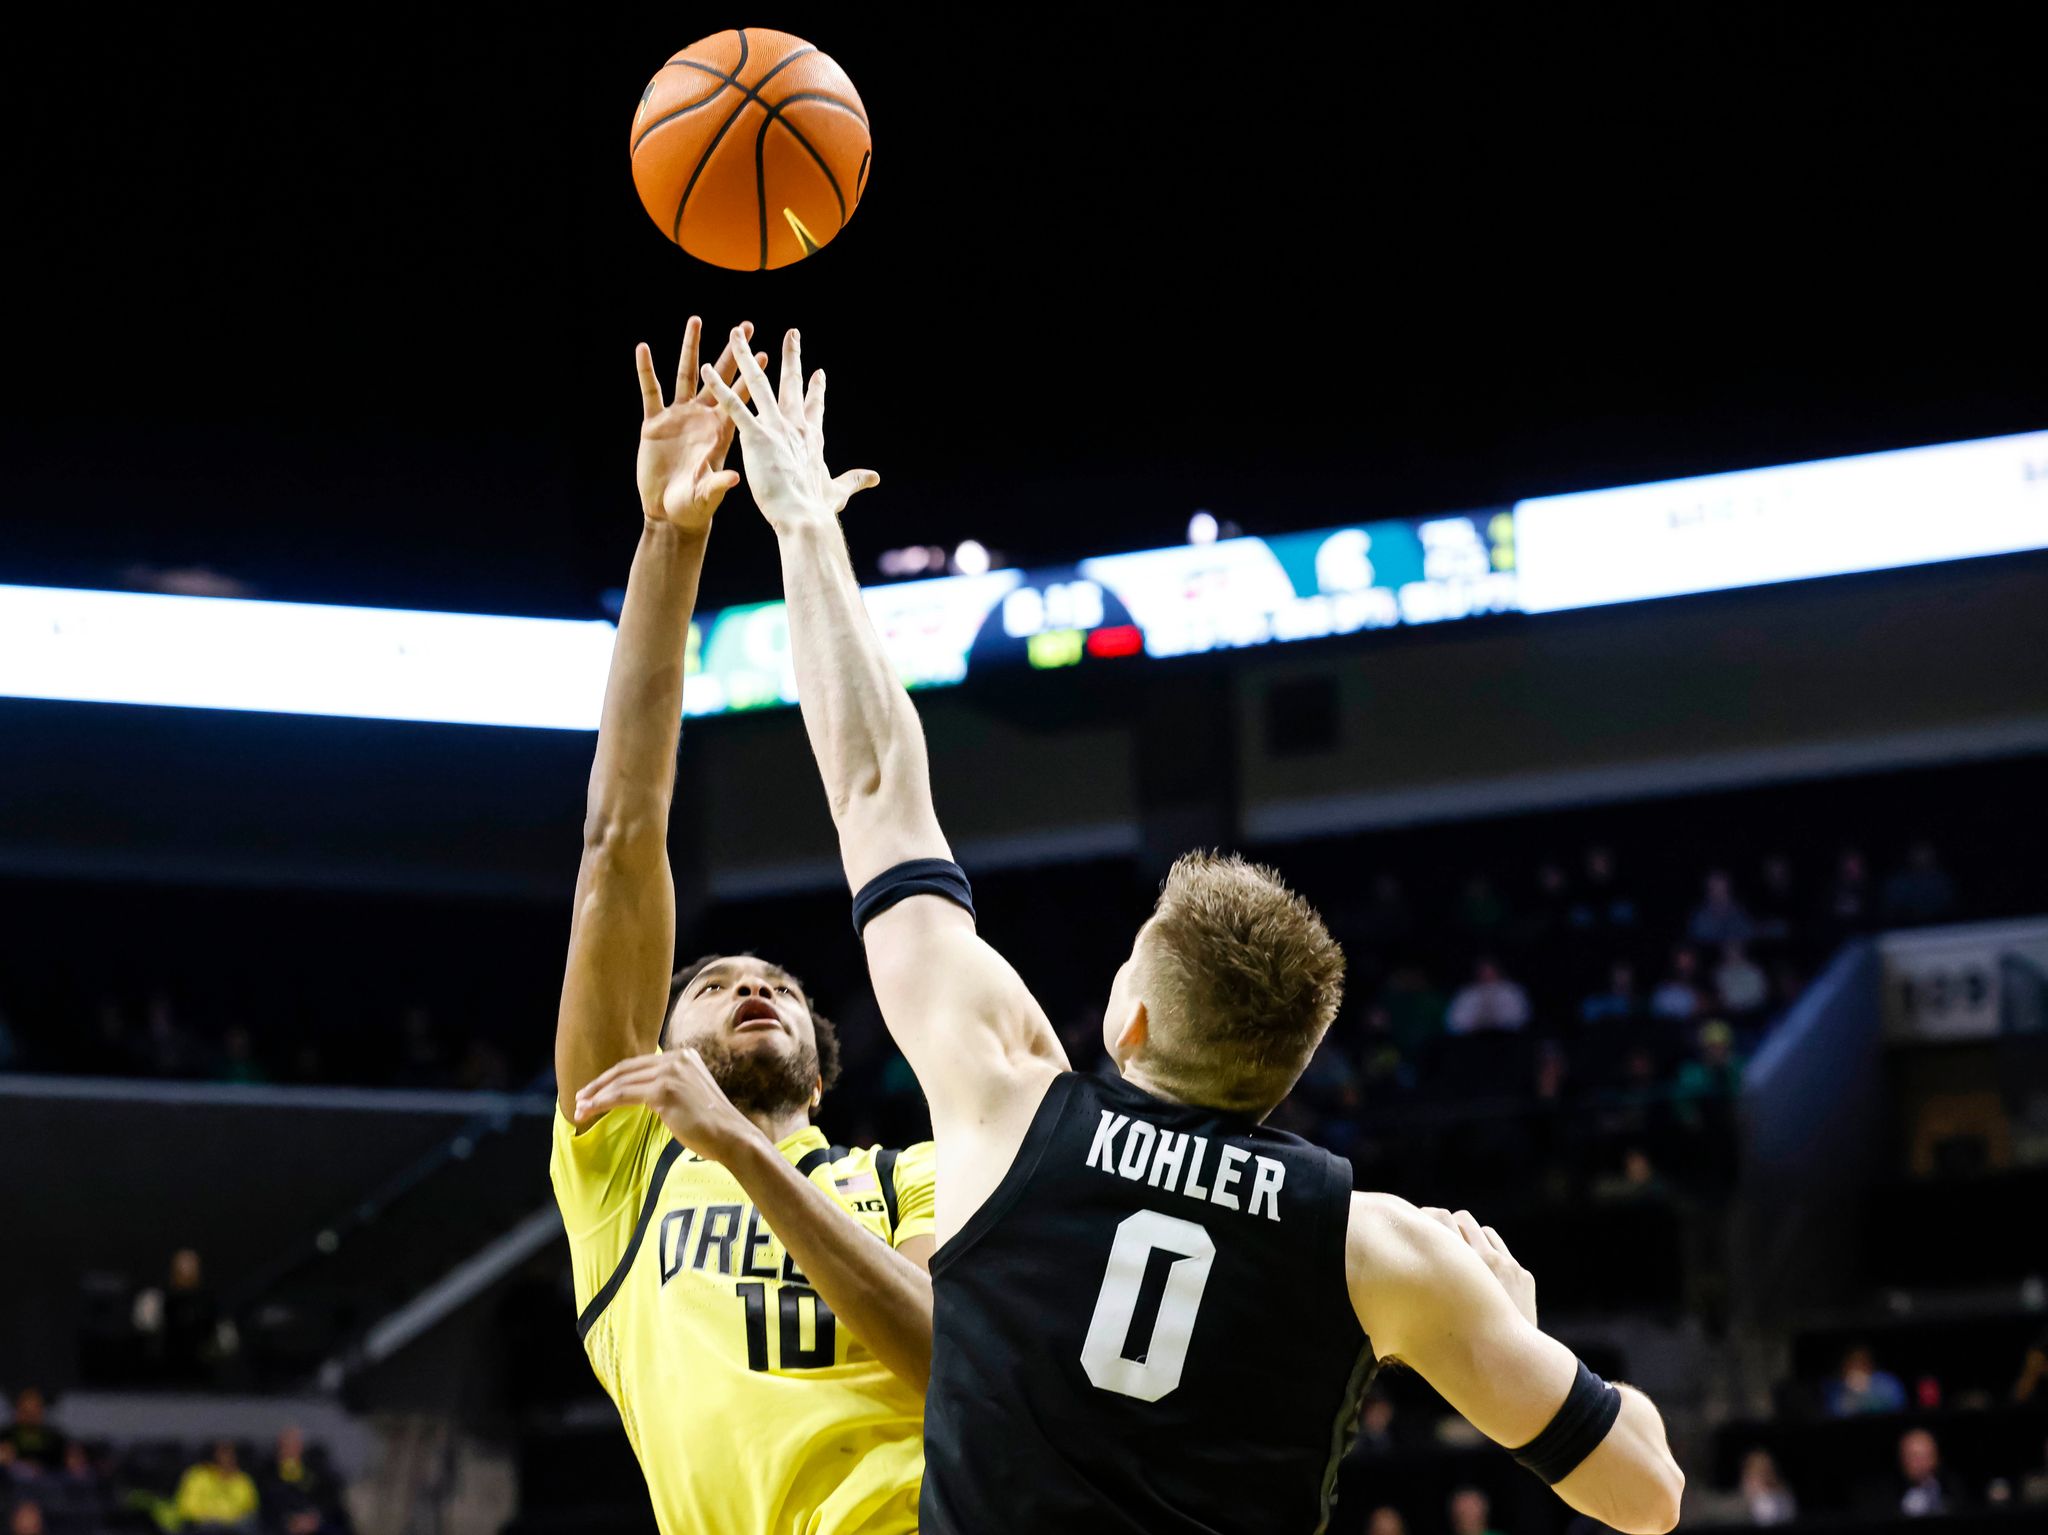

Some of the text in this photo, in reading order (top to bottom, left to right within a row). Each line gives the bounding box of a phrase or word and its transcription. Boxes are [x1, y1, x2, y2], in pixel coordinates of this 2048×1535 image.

[1085, 1109, 1287, 1222] KOHLER
[659, 1204, 812, 1288] ORE
[735, 1281, 837, 1372] 10
[1079, 1208, 1217, 1403] 0
